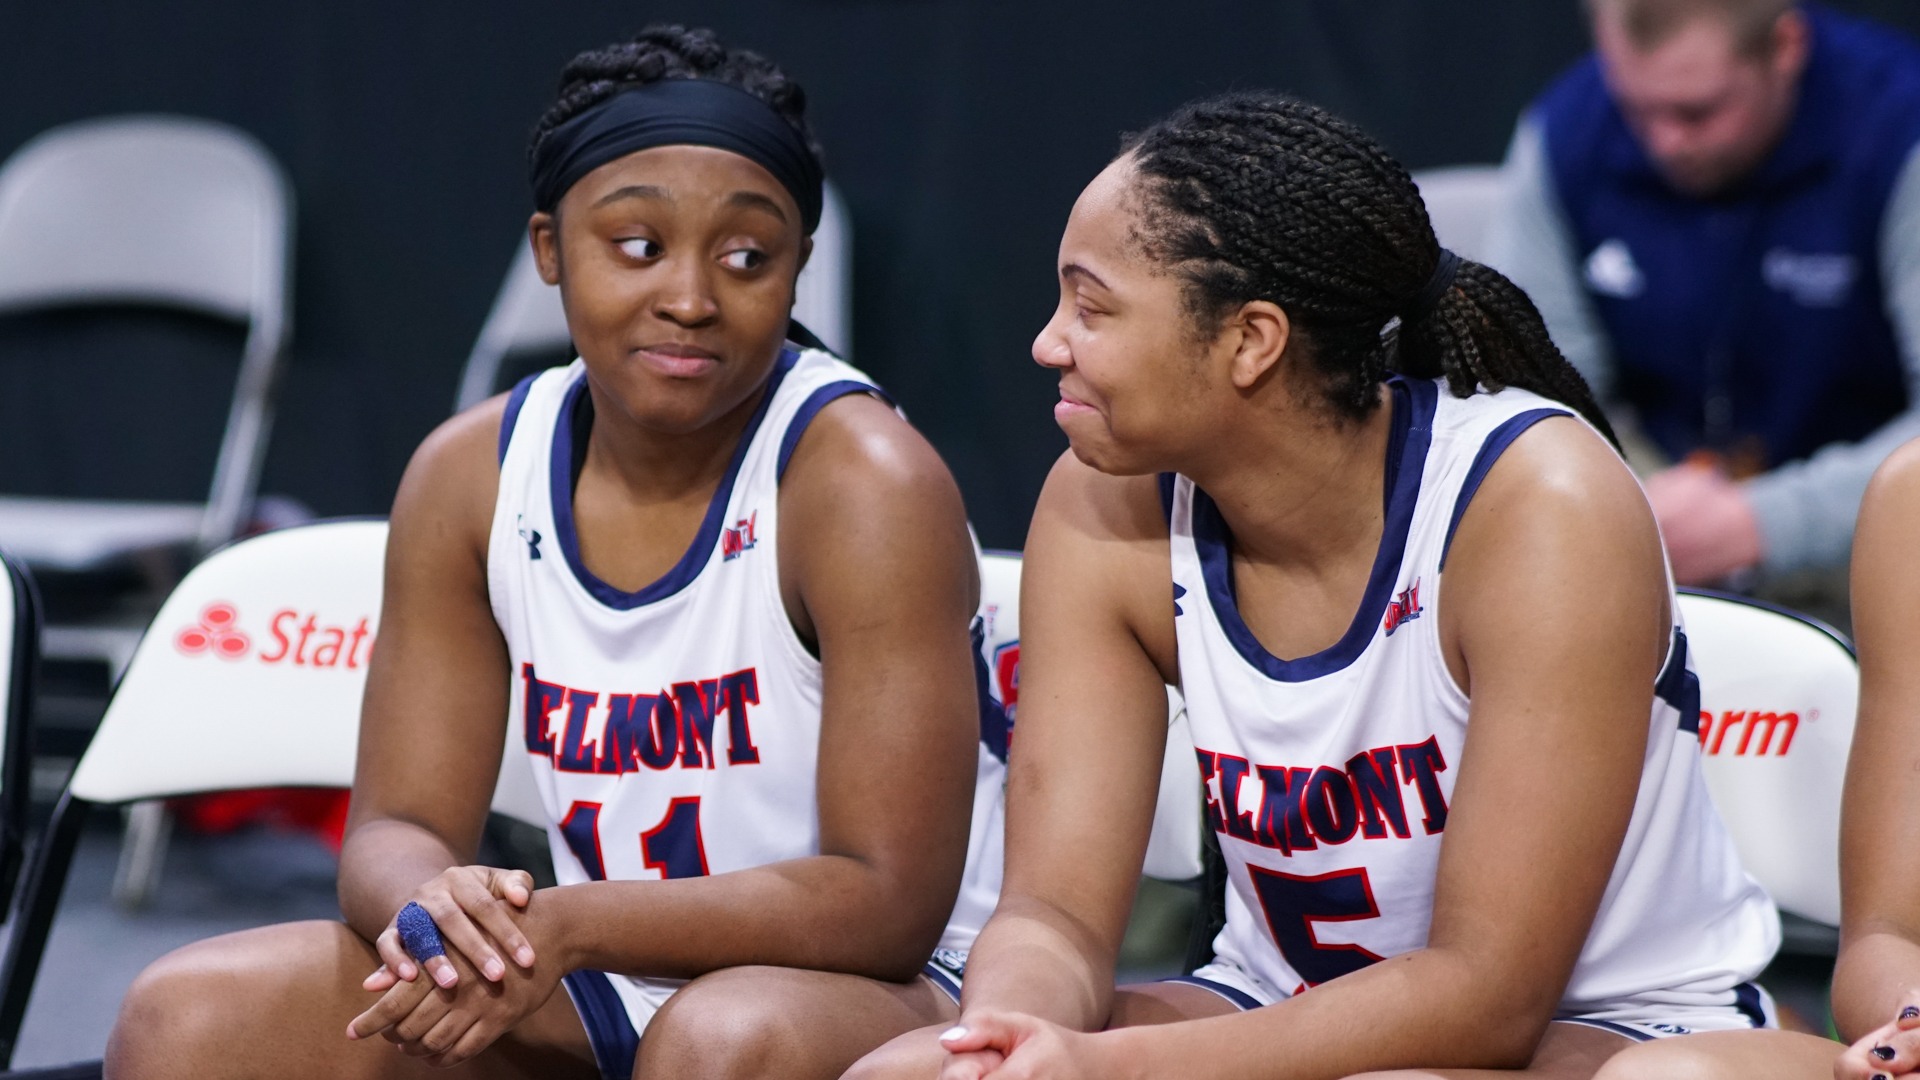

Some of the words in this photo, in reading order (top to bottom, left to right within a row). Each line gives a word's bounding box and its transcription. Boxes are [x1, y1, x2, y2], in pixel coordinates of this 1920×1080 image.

[262, 610, 375, 668] Stat
[558, 796, 710, 881] 11
[1194, 734, 1448, 858] ELMONT
[1246, 862, 1388, 992] 5
